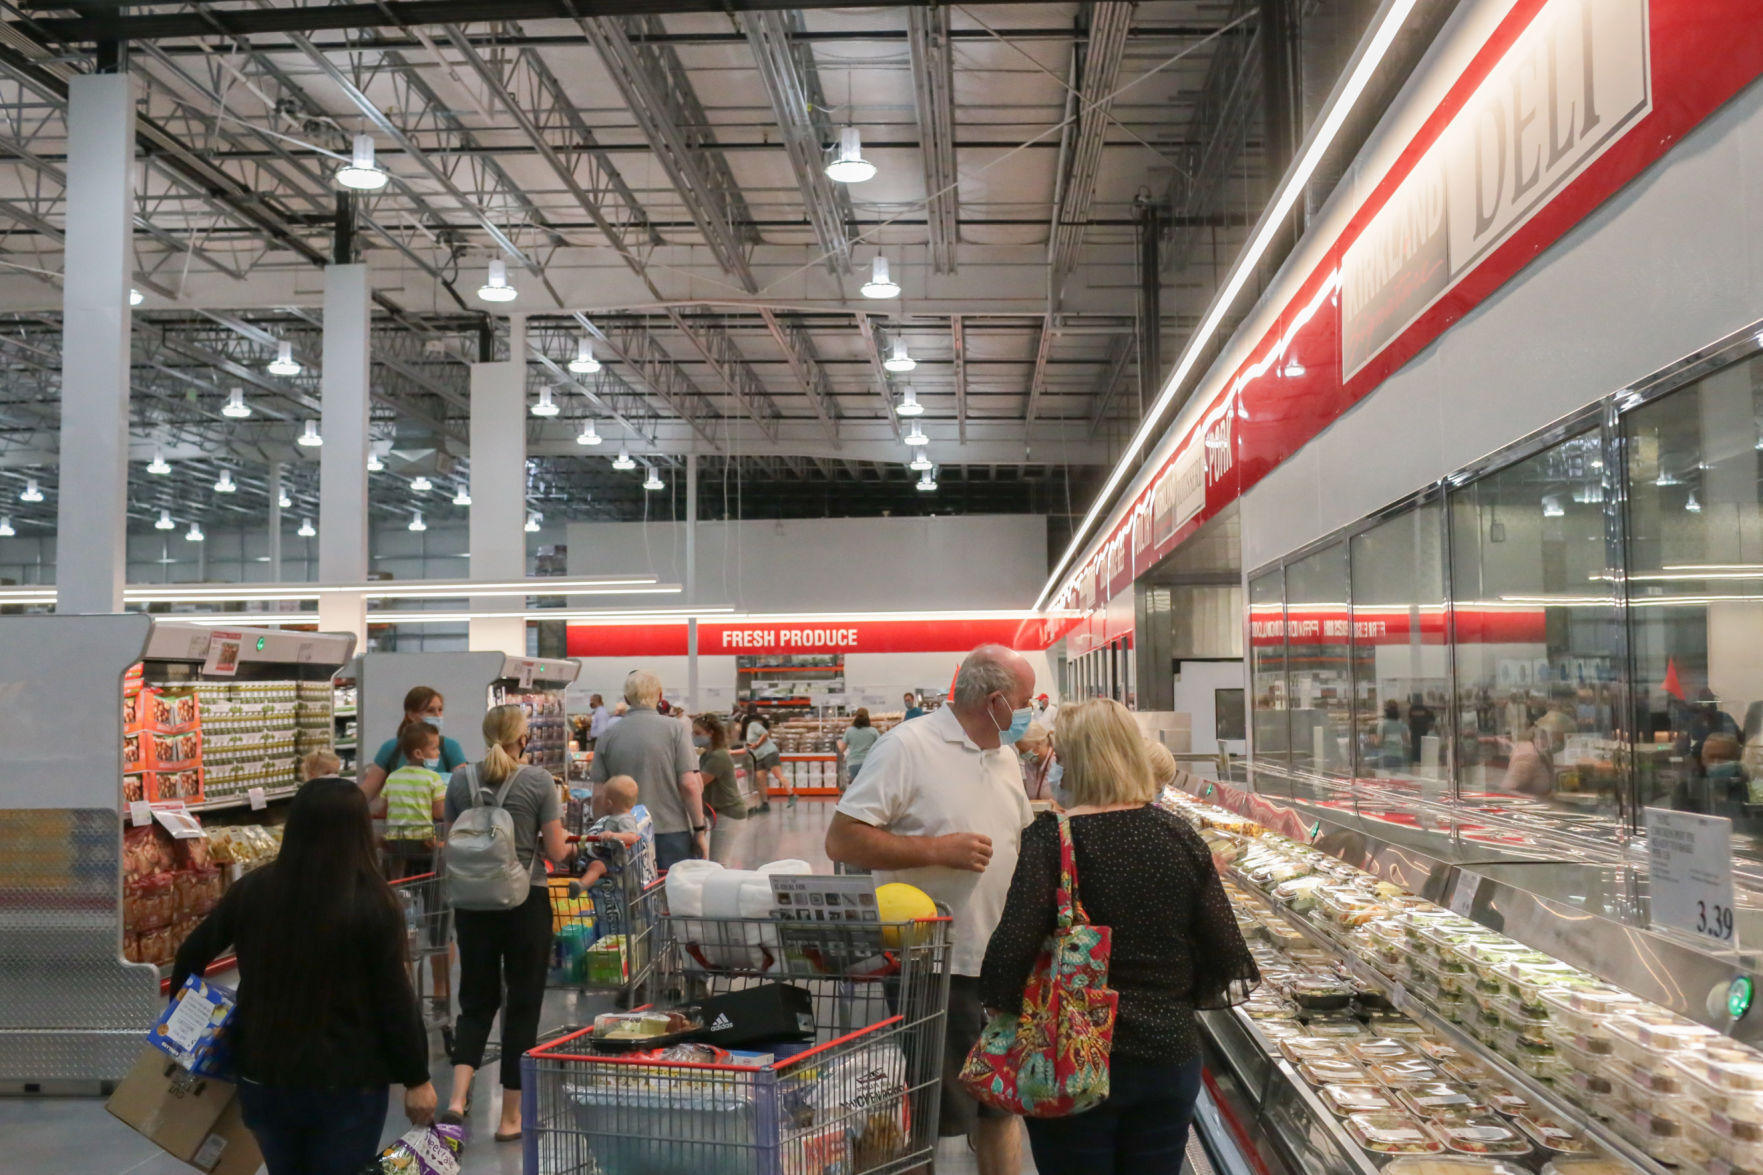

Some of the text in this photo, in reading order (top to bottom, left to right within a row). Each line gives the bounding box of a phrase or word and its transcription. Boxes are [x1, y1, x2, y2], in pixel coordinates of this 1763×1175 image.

[1473, 0, 1601, 242] DELI
[1208, 411, 1233, 488] PORK
[722, 629, 859, 647] FRESH PRODUCE
[1696, 899, 1734, 941] 3.39
[710, 1021, 734, 1032] adidas
